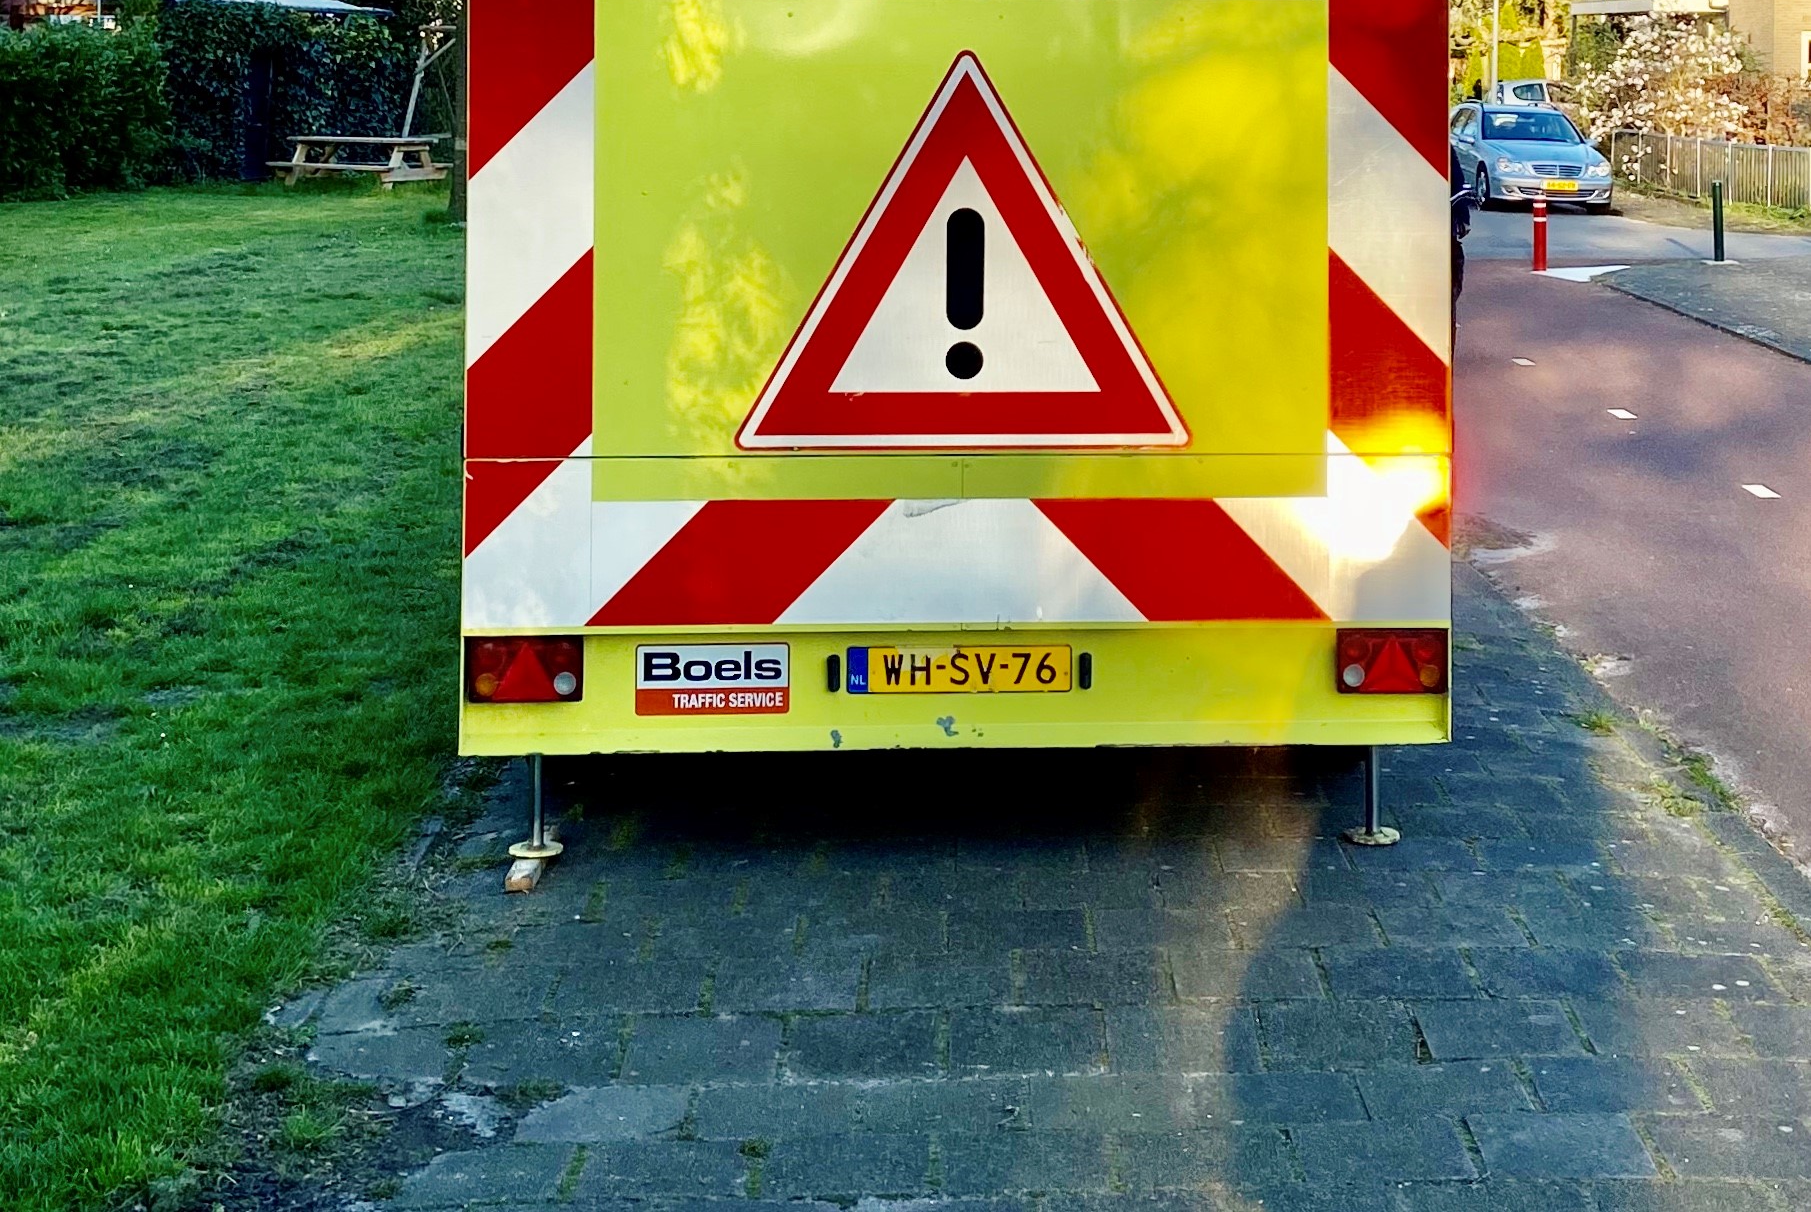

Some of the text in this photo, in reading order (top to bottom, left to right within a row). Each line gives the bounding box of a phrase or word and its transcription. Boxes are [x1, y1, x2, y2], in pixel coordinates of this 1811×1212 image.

[643, 650, 782, 682] Boels
[883, 652, 1057, 686] WH-SV-76
[850, 674, 866, 686] NL
[672, 691, 784, 709] TRAFFIC SERVICE
